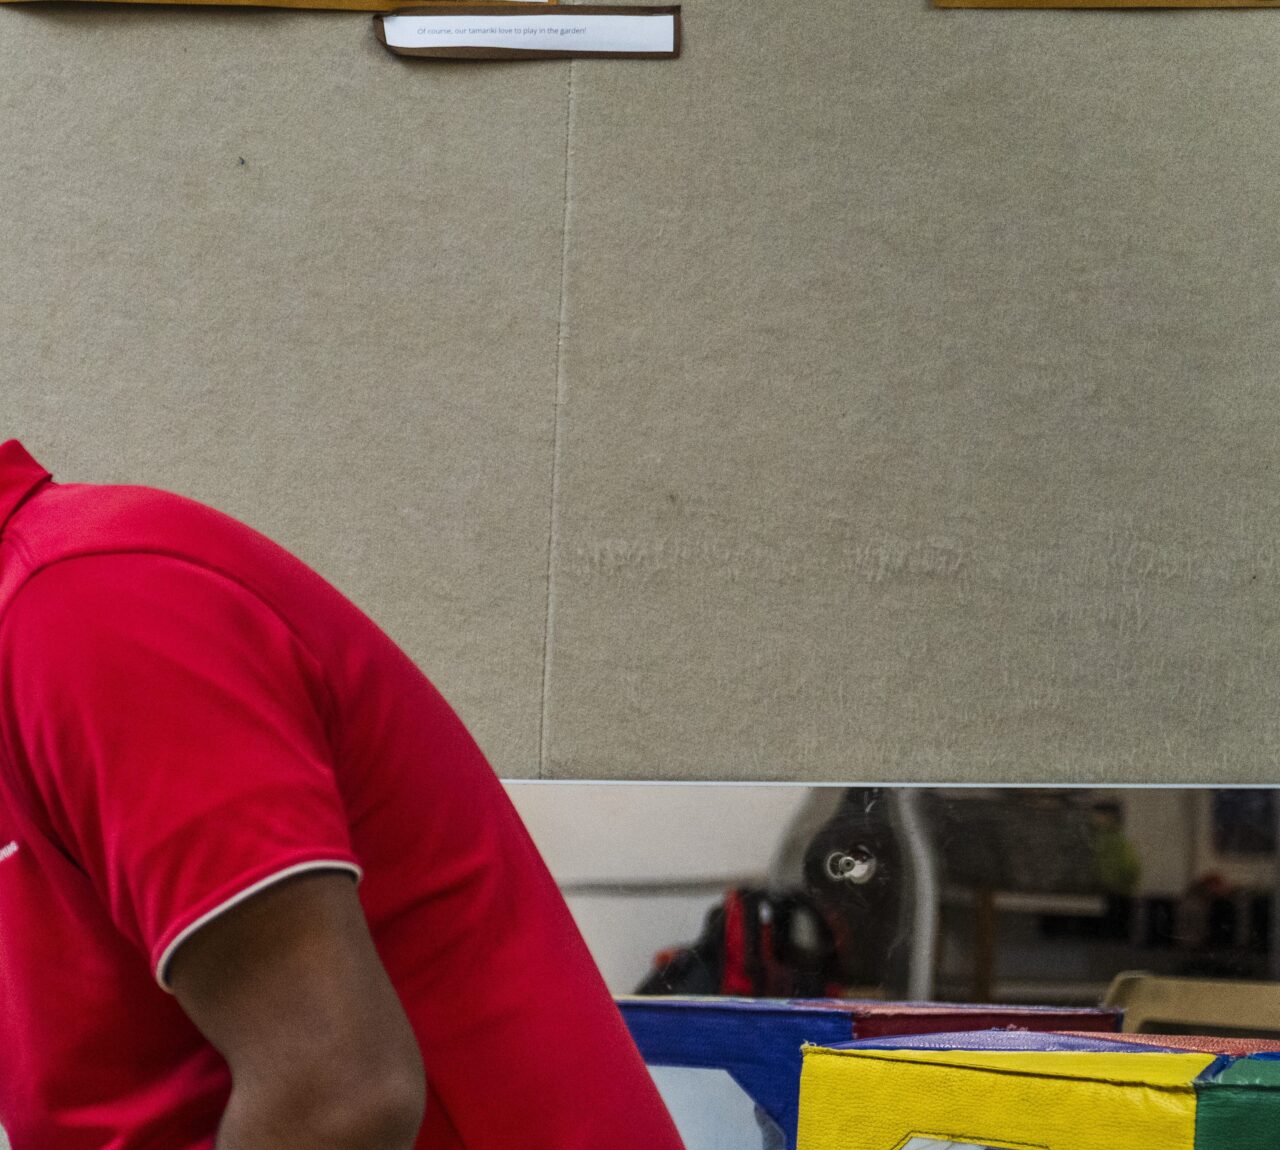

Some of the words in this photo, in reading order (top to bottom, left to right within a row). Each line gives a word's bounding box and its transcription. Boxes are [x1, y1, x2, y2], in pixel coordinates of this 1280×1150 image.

[469, 26, 497, 34] tamariki
[499, 26, 512, 34] love
[523, 27, 537, 36] play
[547, 26, 559, 34] the
